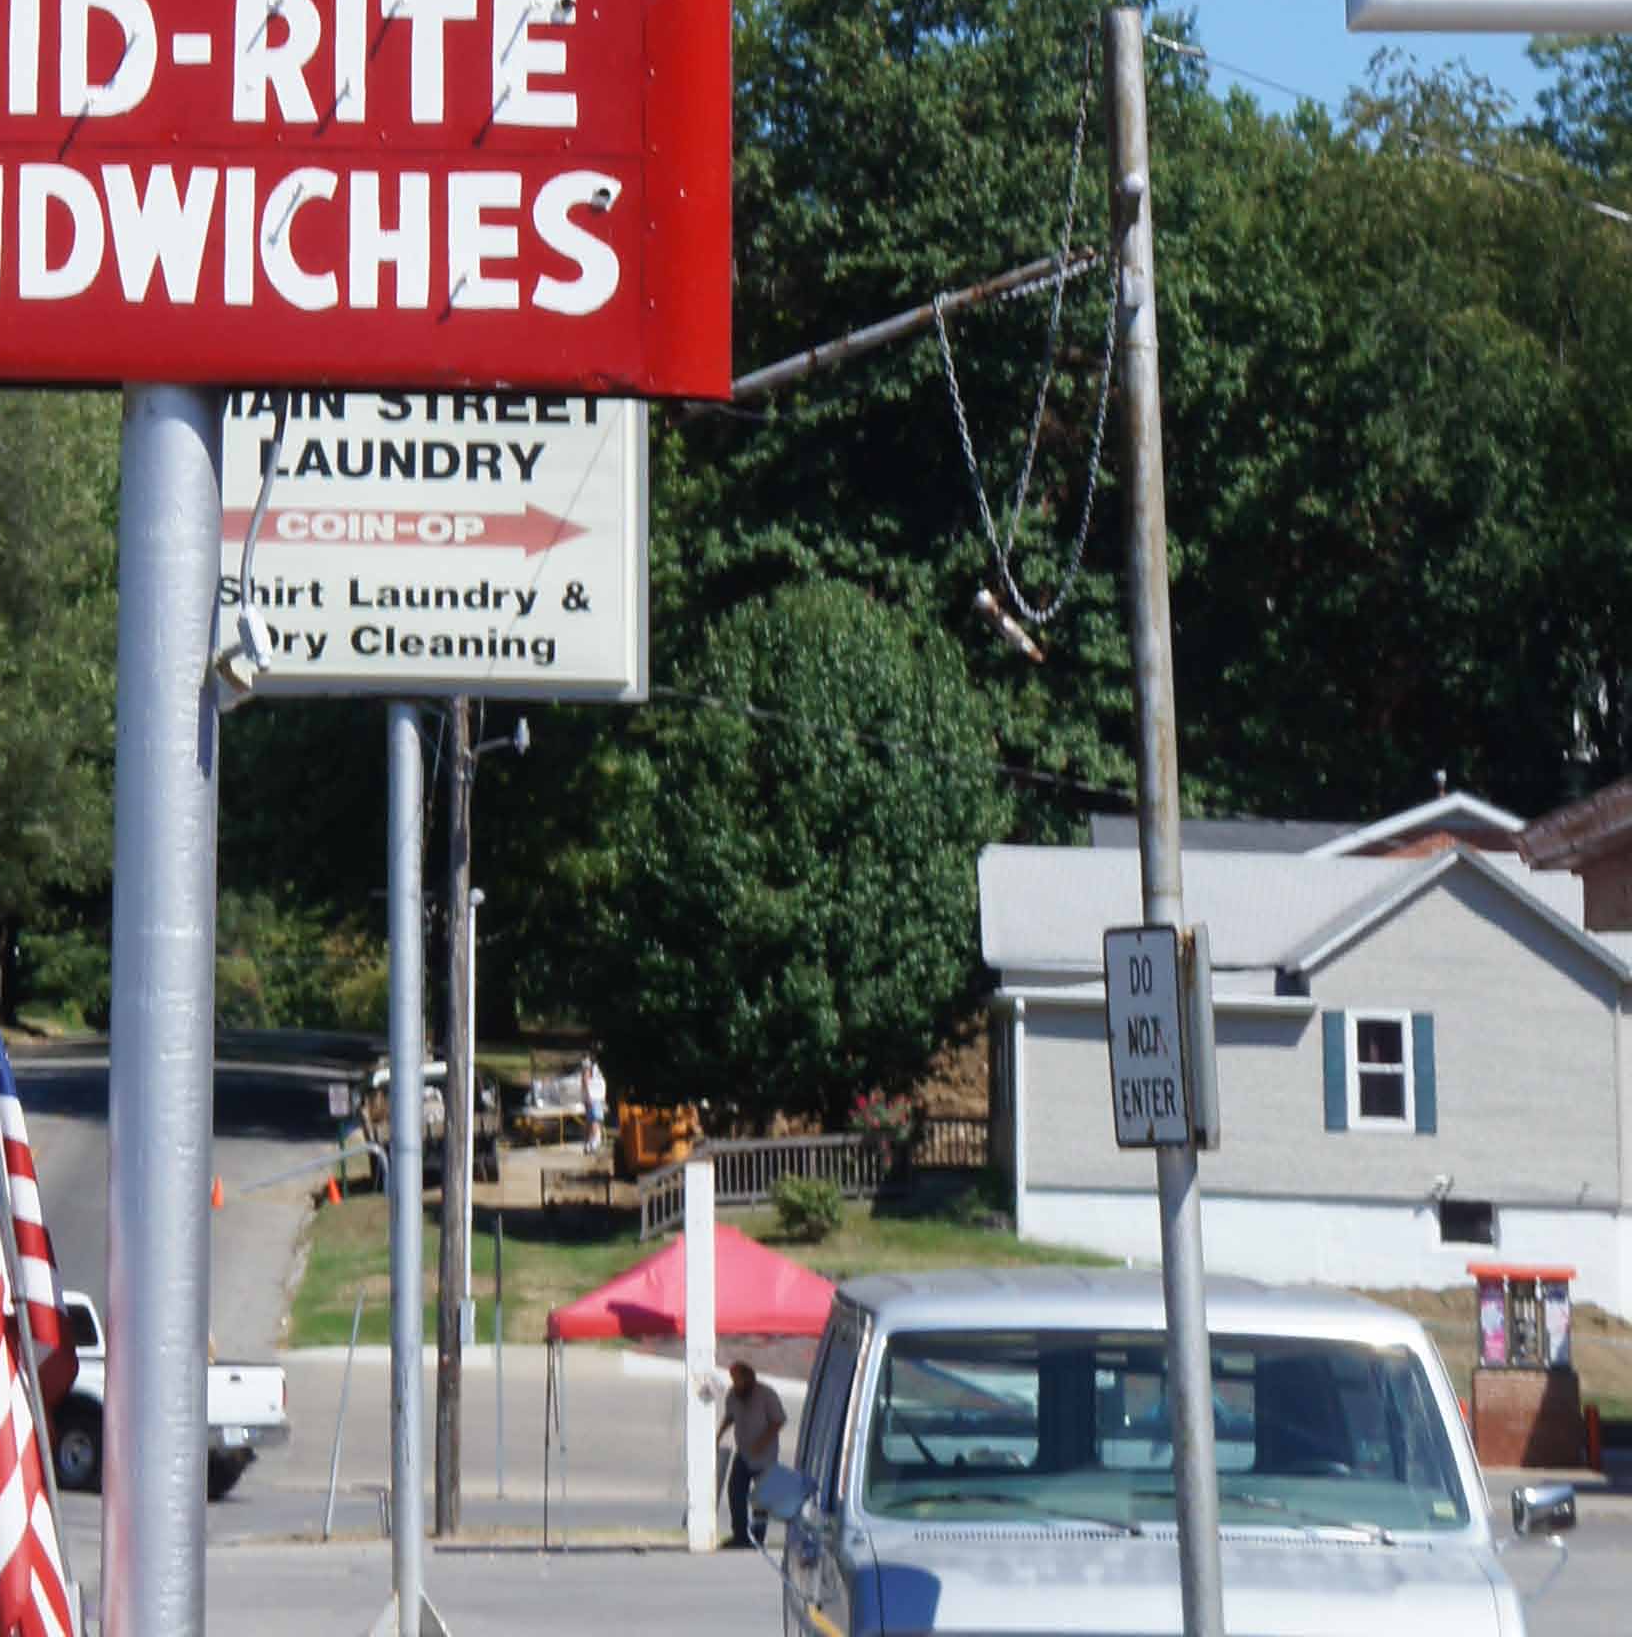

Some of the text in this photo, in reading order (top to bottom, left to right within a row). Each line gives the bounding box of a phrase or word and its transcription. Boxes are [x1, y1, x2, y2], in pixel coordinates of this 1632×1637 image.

[230, 389, 345, 419] AIN
[259, 438, 546, 481] LAUNDRY
[276, 511, 485, 545] COIN-OP
[220, 576, 591, 616] Shirt Laundry &
[350, 624, 557, 666] Cleaning
[1129, 955, 1153, 996] DO
[1127, 1015, 1162, 1058] NOT
[1120, 1076, 1178, 1119] ENTER
